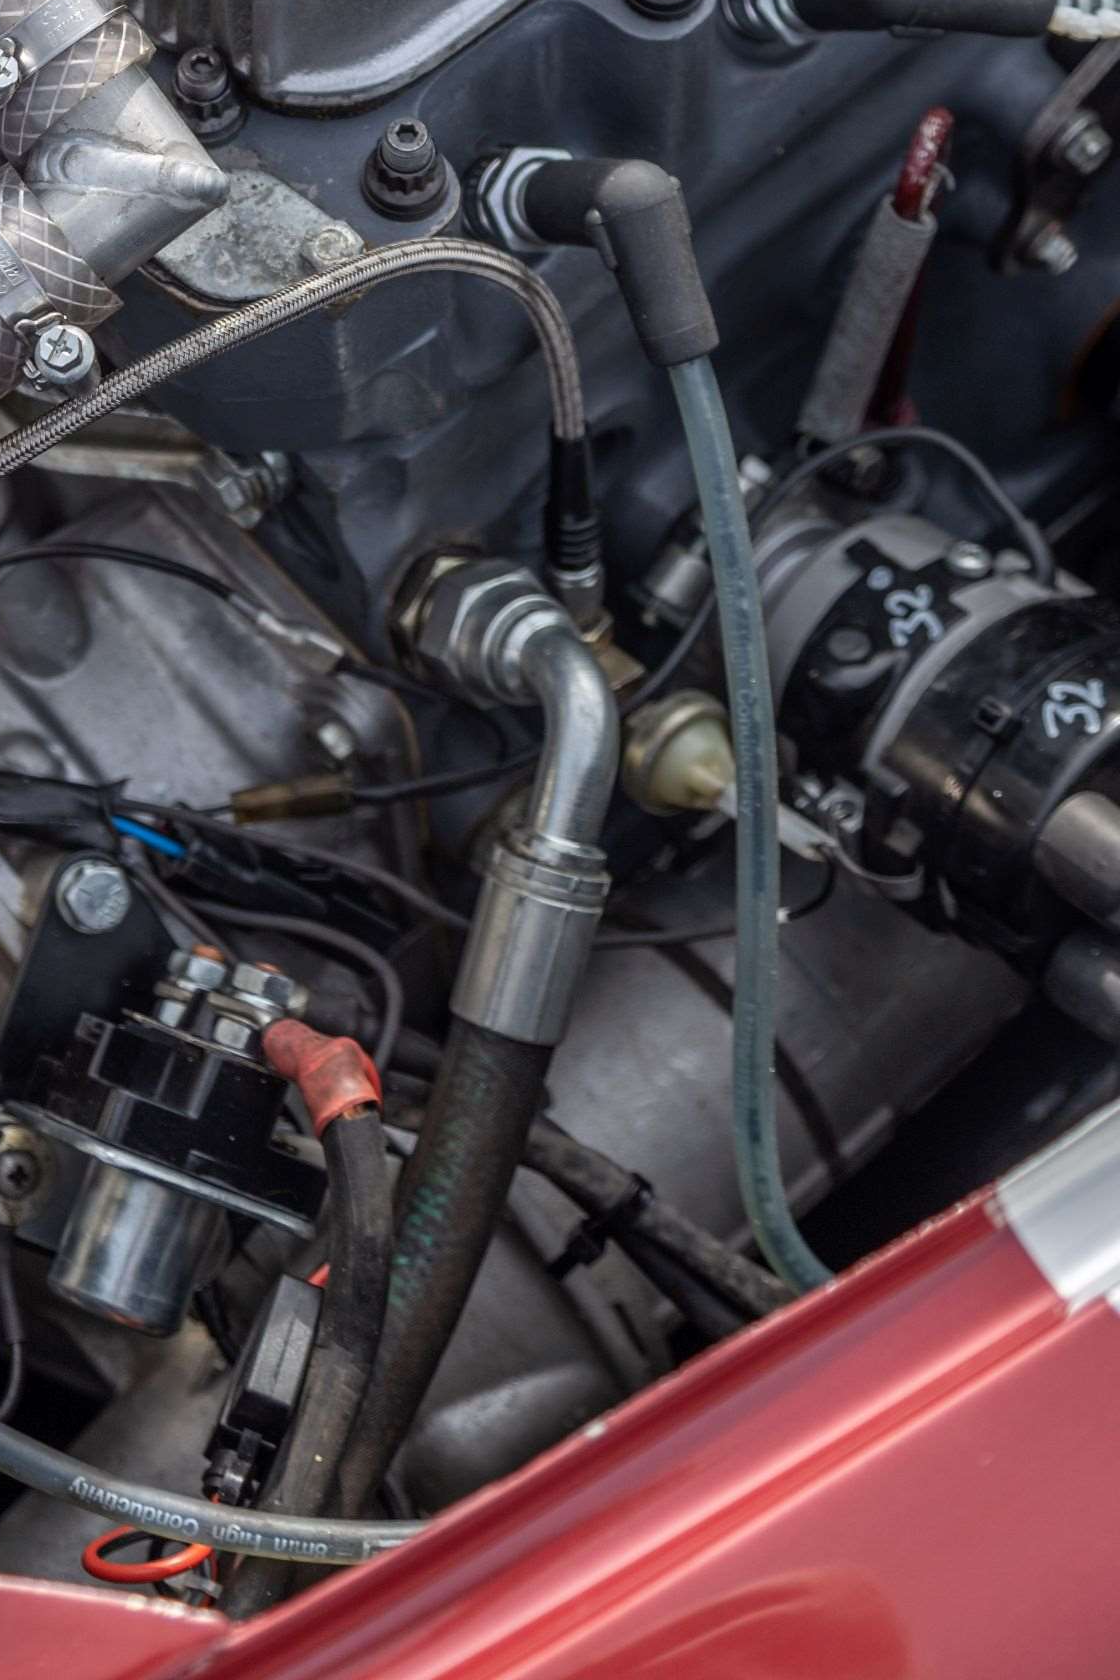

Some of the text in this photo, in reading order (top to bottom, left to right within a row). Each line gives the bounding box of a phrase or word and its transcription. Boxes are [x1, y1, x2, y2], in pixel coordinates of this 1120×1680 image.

[883, 583, 944, 648] 32
[1042, 677, 1108, 739] 32
[68, 1474, 200, 1543] Conductivity
